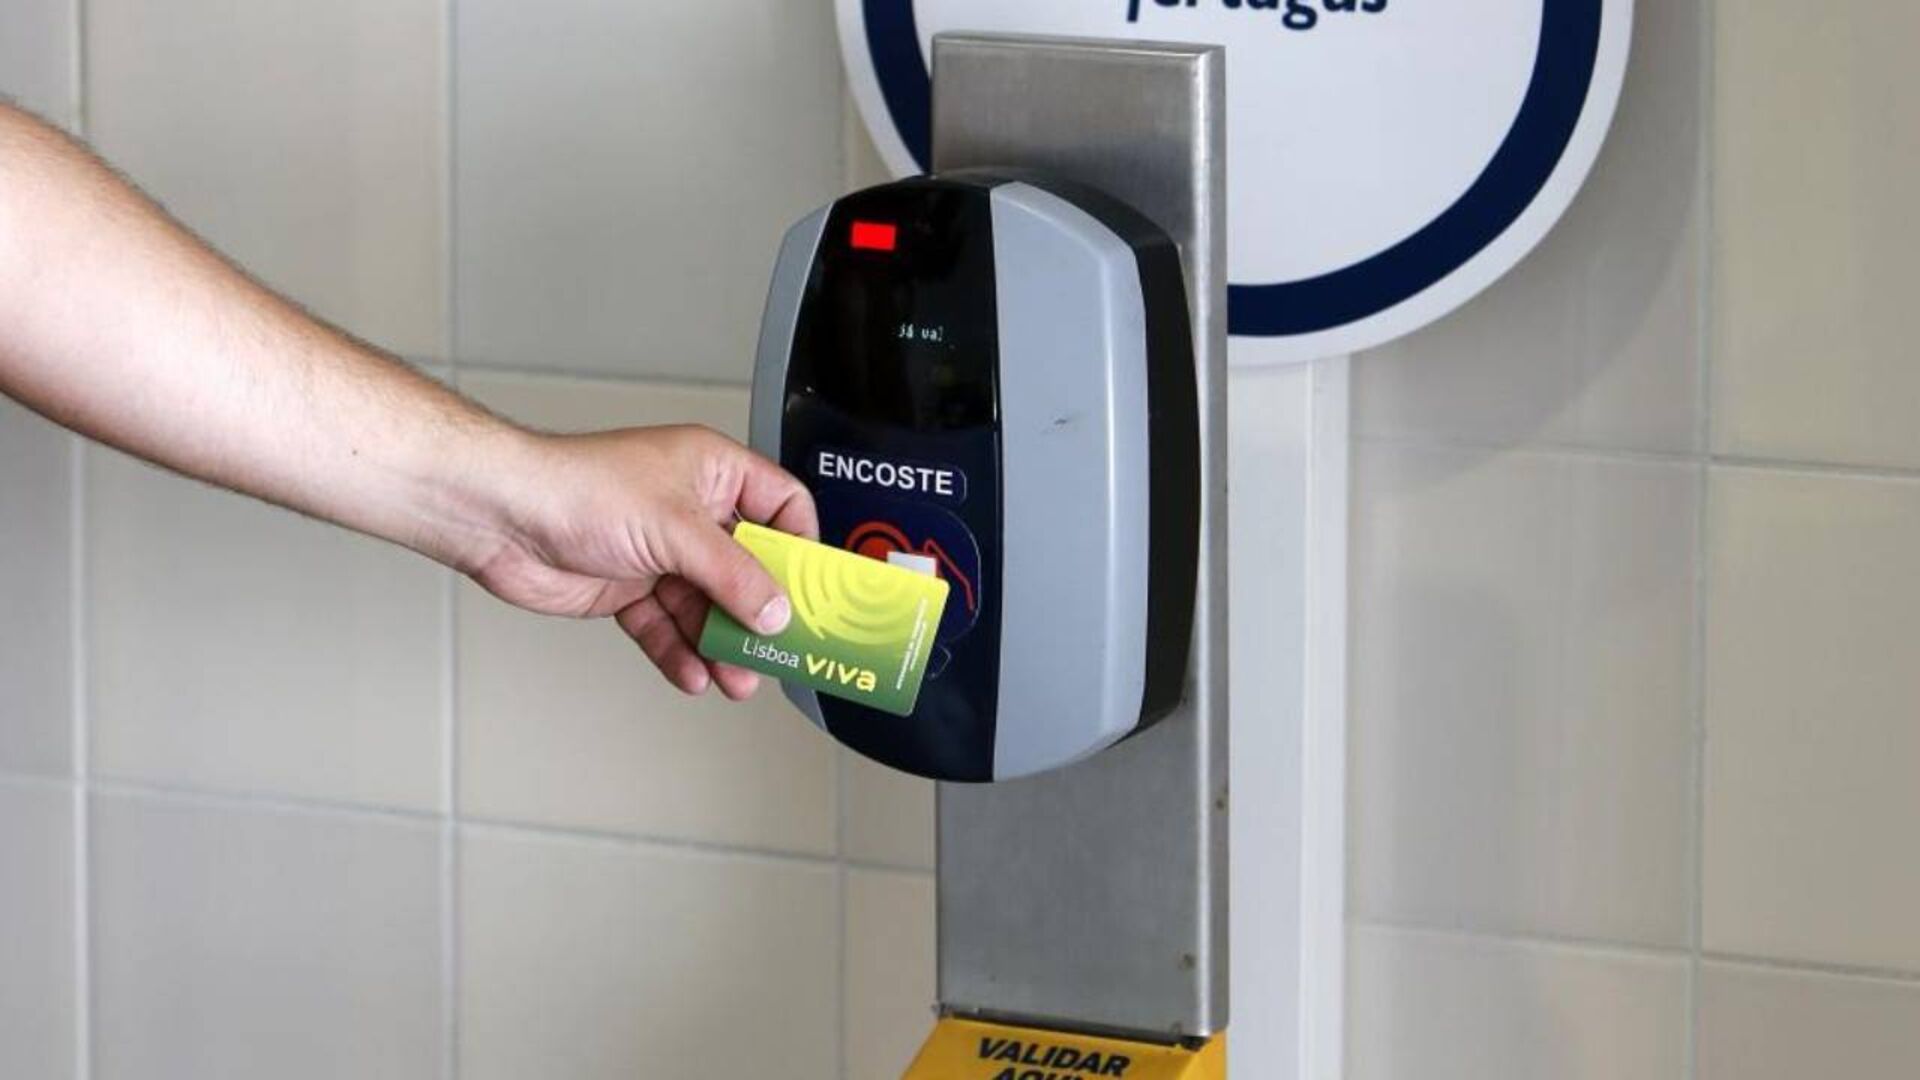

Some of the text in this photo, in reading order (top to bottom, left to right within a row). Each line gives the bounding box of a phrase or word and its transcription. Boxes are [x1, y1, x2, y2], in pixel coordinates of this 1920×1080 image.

[818, 451, 953, 496] ENCOSTE
[742, 637, 800, 669] Lisboa
[978, 1037, 1131, 1077] VALIDAR
